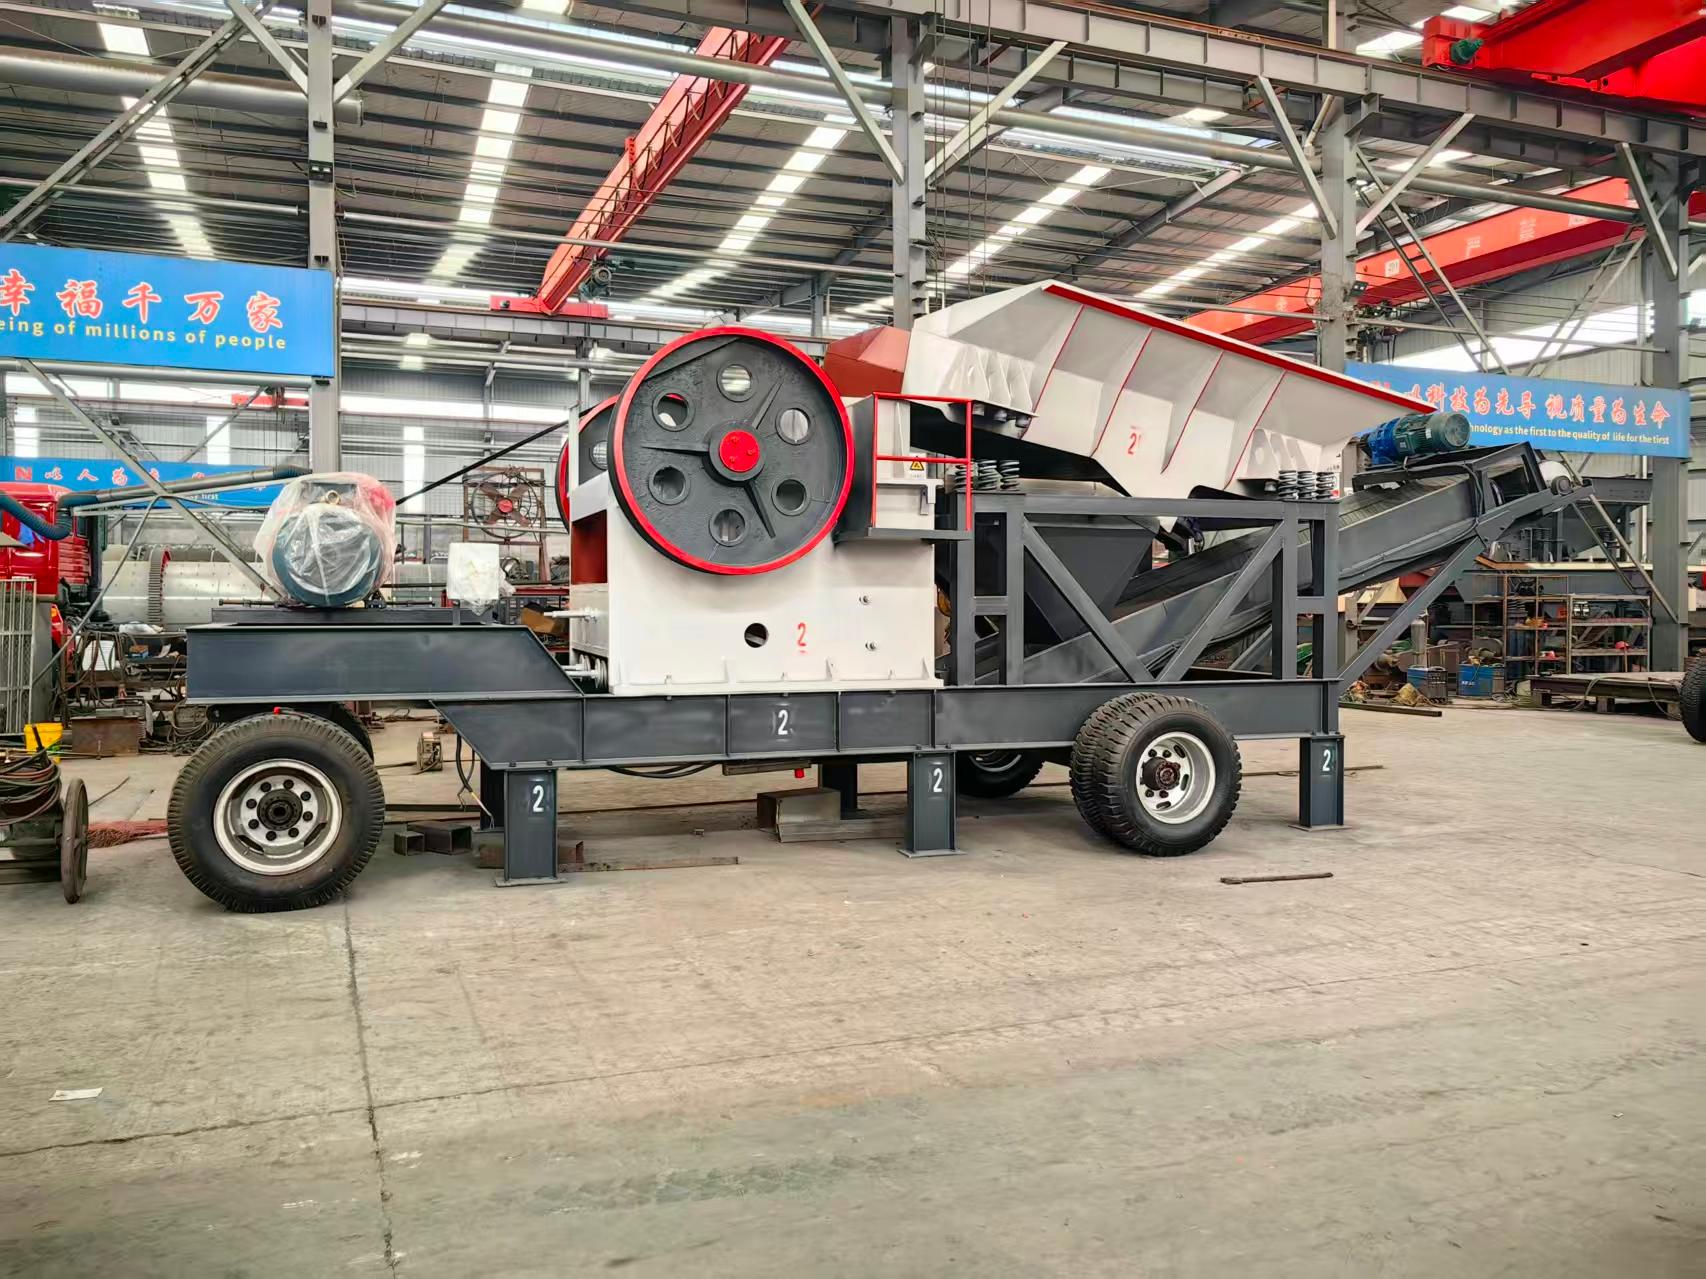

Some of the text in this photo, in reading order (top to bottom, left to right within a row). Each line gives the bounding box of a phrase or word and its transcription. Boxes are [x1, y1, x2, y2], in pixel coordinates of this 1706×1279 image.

[0, 268, 283, 333] 幸福千万家
[54, 320, 76, 335] of
[85, 323, 176, 342] millions
[185, 330, 206, 344] of
[215, 334, 286, 350] people
[1545, 394, 1671, 429] 视质量为生命
[1504, 426, 1514, 434] as
[1515, 425, 1529, 435] the
[1530, 426, 1547, 436] first
[1548, 428, 1557, 437] to
[1558, 427, 1572, 438] the
[1572, 430, 1601, 442] quality
[1602, 431, 1610, 441] of
[797, 622, 806, 647] 2
[777, 709, 789, 735] 2
[1322, 749, 1331, 772] 2
[933, 767, 943, 793] 2
[533, 784, 544, 813] 2
